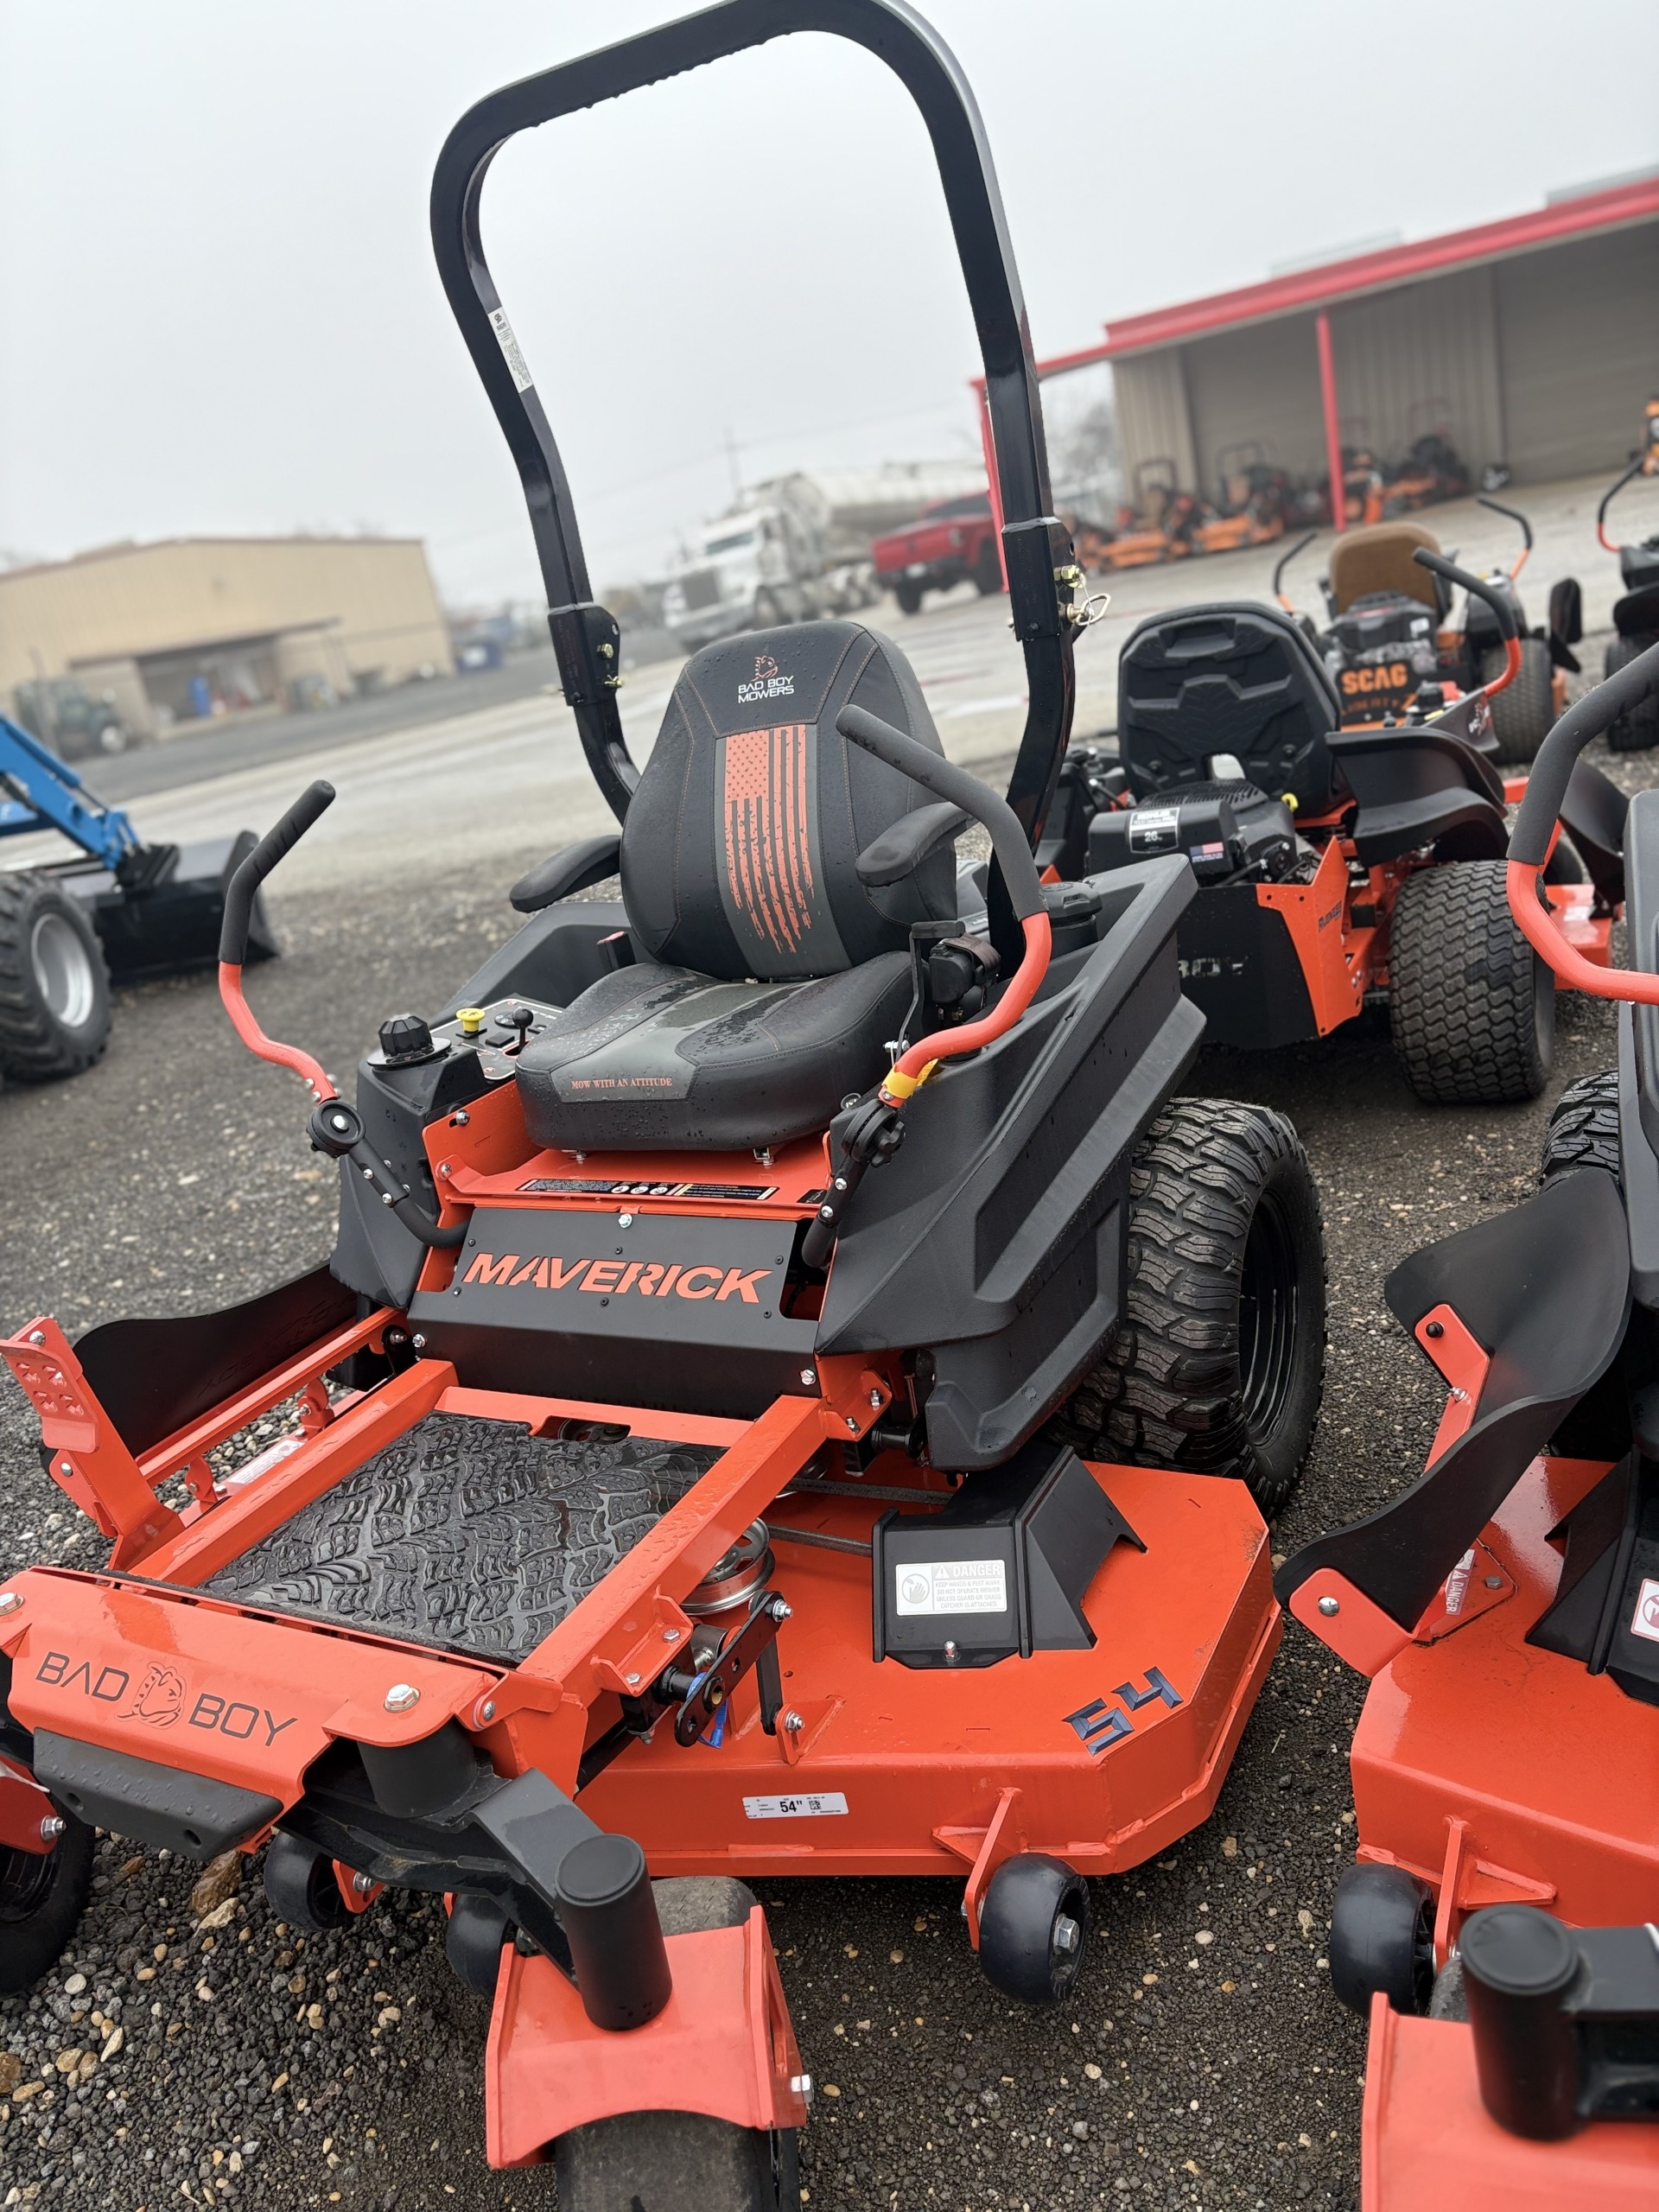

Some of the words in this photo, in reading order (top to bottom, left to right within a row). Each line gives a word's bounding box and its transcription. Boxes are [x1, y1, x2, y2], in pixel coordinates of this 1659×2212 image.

[738, 681, 764, 694] BAD
[767, 676, 794, 688] BOY
[1341, 663, 1408, 695] SCAG
[738, 685, 795, 703] MOWERS
[1145, 830, 1158, 842] 26
[571, 1080, 592, 1090] MOW
[593, 1078, 615, 1089] WITH
[617, 1077, 629, 1087] AN
[631, 1077, 672, 1087] ATTITUDE
[461, 1252, 773, 1304] MAVERICK
[952, 1563, 1001, 1578] DANGER
[1446, 1581, 1465, 1613] DANGER
[35, 1651, 130, 1702] BAD
[188, 1693, 299, 1747] BOY
[1060, 1666, 1185, 1758] 54
[779, 1800, 803, 1813] 54"
